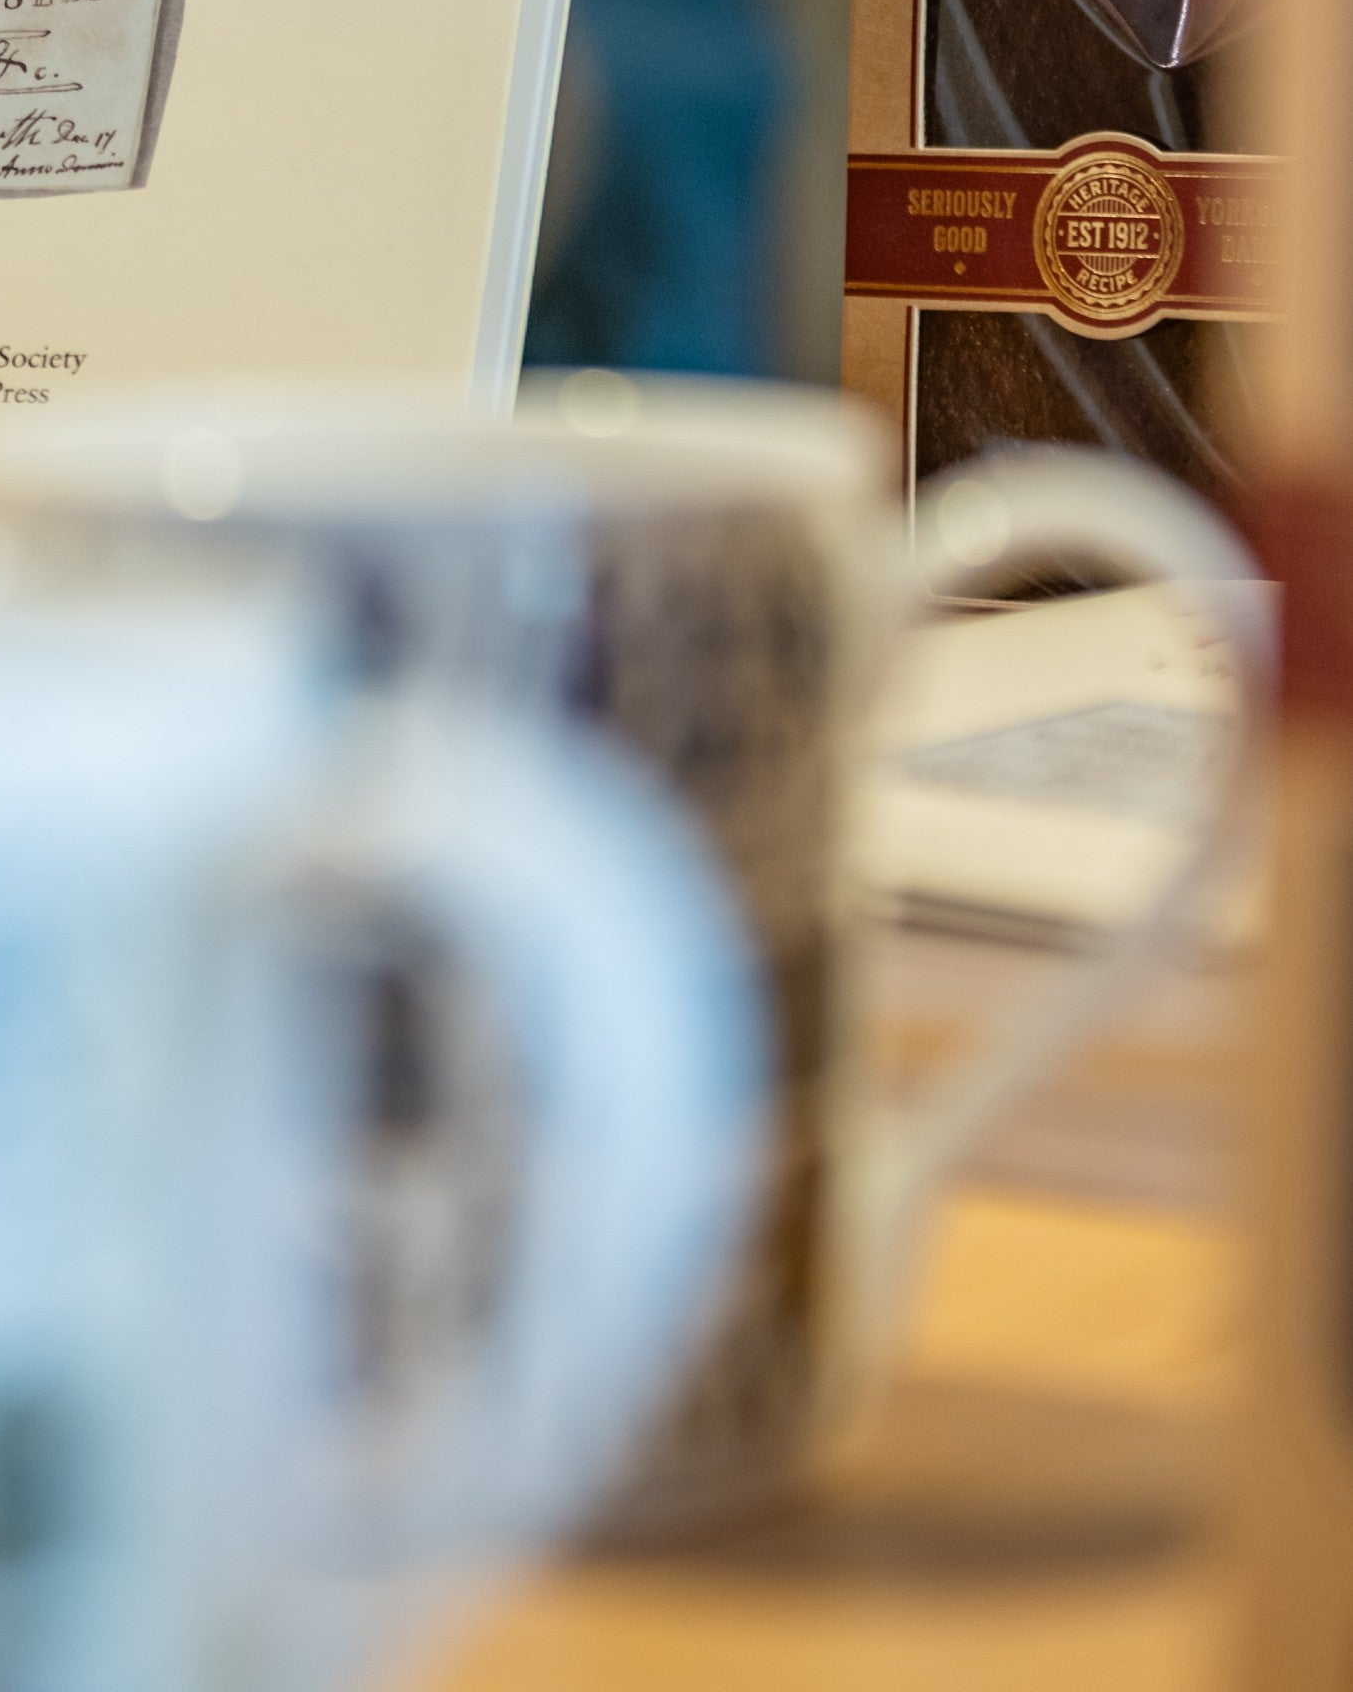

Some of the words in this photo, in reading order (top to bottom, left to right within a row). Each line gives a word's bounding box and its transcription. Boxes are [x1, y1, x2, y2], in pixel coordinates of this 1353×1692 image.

[908, 190, 1017, 218] SERIOUSLY
[1068, 179, 1152, 214] HERITAGE
[933, 226, 988, 253] GOOD
[1066, 222, 1106, 249] EST
[1107, 220, 1148, 250] 1912
[1076, 269, 1139, 294] RECIPE
